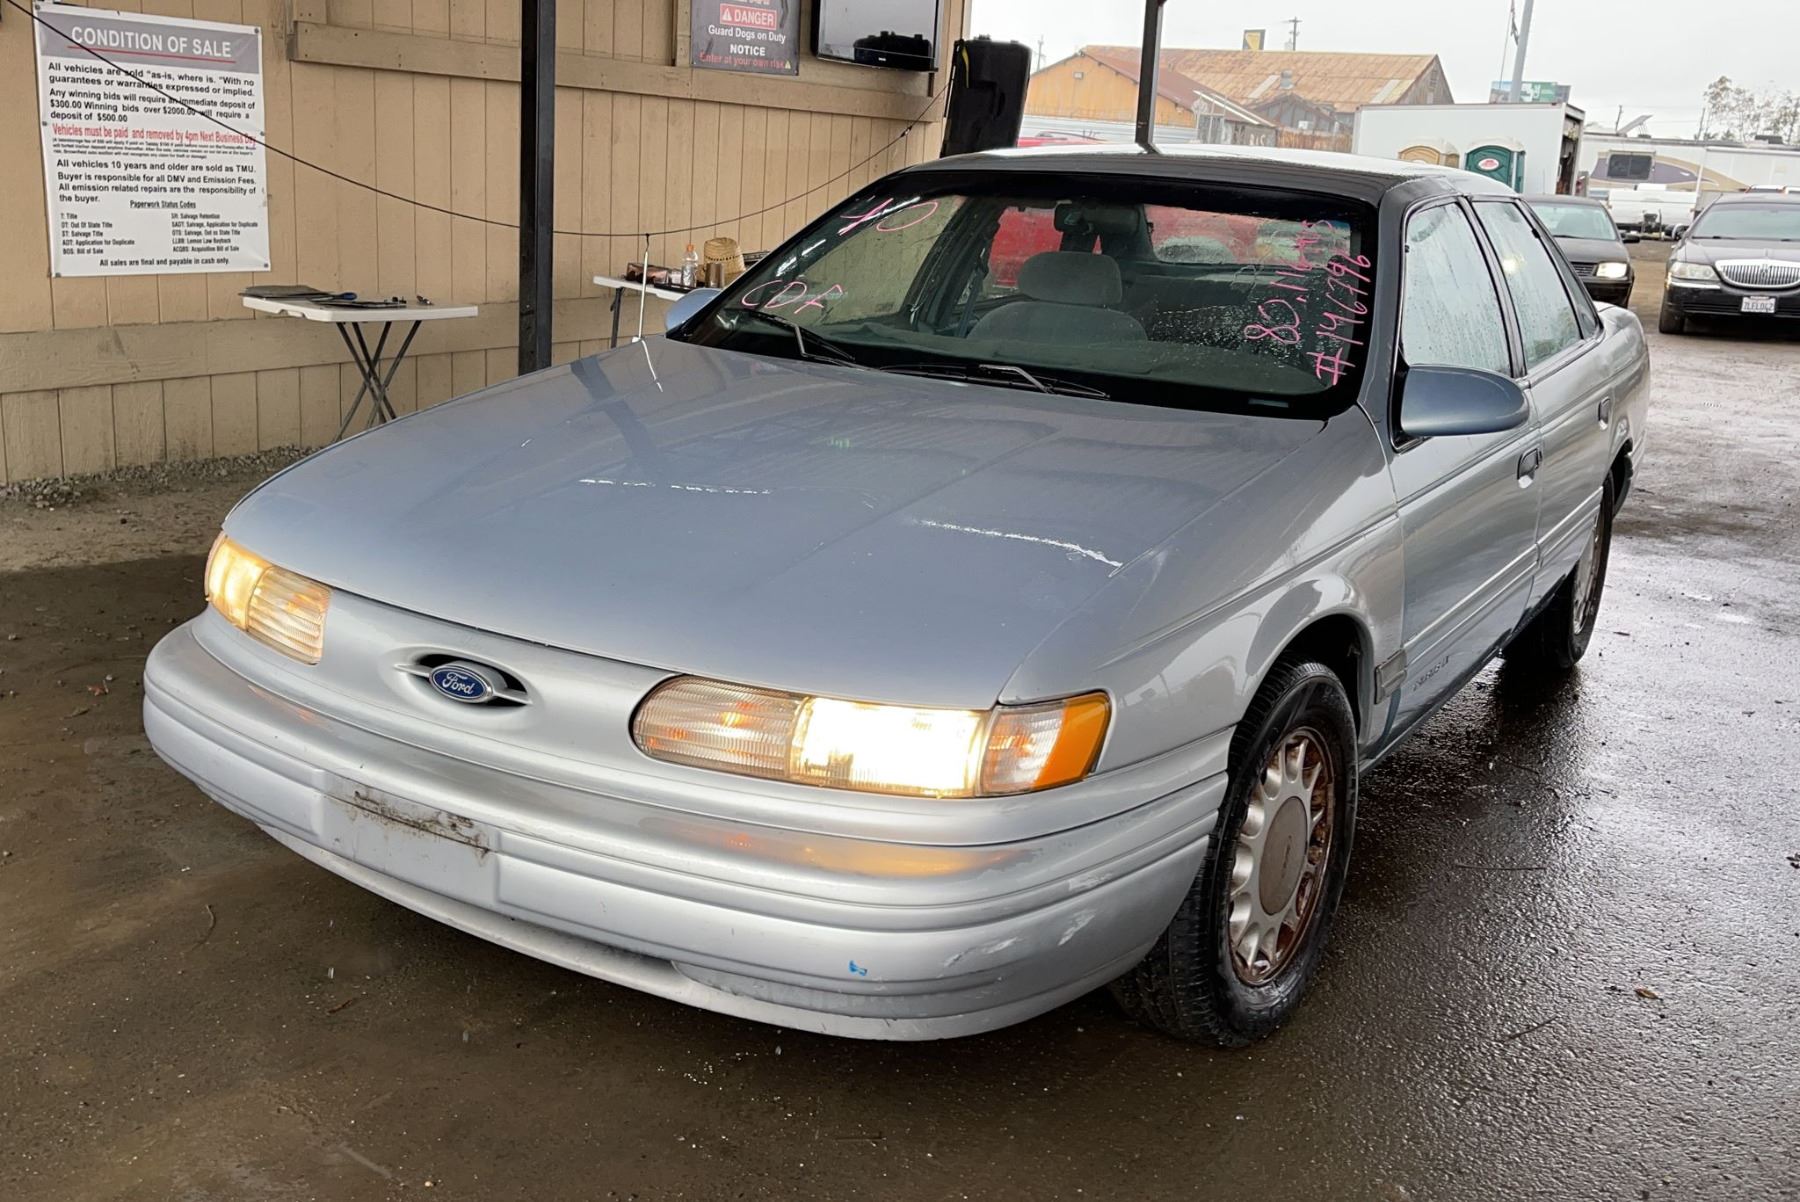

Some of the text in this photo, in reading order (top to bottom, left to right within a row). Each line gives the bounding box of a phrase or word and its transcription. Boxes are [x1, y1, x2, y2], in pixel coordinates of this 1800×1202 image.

[734, 9, 774, 26] DANGER
[71, 26, 232, 58] CONDITION OF SALE
[708, 24, 734, 36] Guard
[735, 28, 756, 40] Dogs
[768, 32, 786, 44] Duty
[730, 44, 766, 56] NOTICE
[48, 62, 60, 71] All
[64, 64, 103, 74] vehicles
[178, 74, 203, 82] where
[206, 75, 216, 83] is.
[49, 75, 102, 85] guarantees
[166, 84, 210, 93] expressed
[223, 86, 254, 96] implied.
[49, 88, 66, 98] Any
[68, 90, 101, 101] winning
[104, 91, 121, 100] bids
[123, 93, 136, 102] will
[138, 95, 166, 104] require
[180, 96, 218, 106] immediate
[220, 100, 246, 109] deposit
[50, 99, 82, 109] $300.00
[84, 101, 118, 113] Winning
[122, 104, 139, 112] bids
[144, 106, 160, 114] over
[163, 106, 196, 116] $2000.00
[216, 111, 242, 119] require
[50, 110, 128, 122] deposit of $500.00
[52, 122, 82, 136] Vehicles
[84, 126, 102, 137] must
[104, 125, 112, 138] be
[114, 126, 128, 139] paid
[132, 127, 144, 138] and
[146, 128, 174, 140] removed
[176, 129, 184, 143] by
[185, 129, 198, 144] 4pm
[200, 130, 214, 142] Next
[216, 131, 243, 144] Business
[57, 159, 69, 168] All
[72, 160, 109, 168] vehicles
[124, 162, 148, 171] years
[150, 162, 166, 170] and
[168, 162, 188, 171] older
[206, 164, 222, 172] sold
[236, 164, 256, 173] TMU.
[58, 172, 256, 184] Buyer is responsible for all DMV and Emission Fees.
[59, 183, 70, 191] All
[112, 184, 138, 192] related
[141, 185, 168, 193] repairs
[184, 185, 195, 193] the
[199, 186, 247, 196] responsibility
[59, 194, 100, 204] the buyer.
[130, 200, 196, 208] Paperwork Status Codes
[110, 258, 127, 266] sales
[169, 258, 192, 267] payable
[441, 672, 476, 695] Ford
